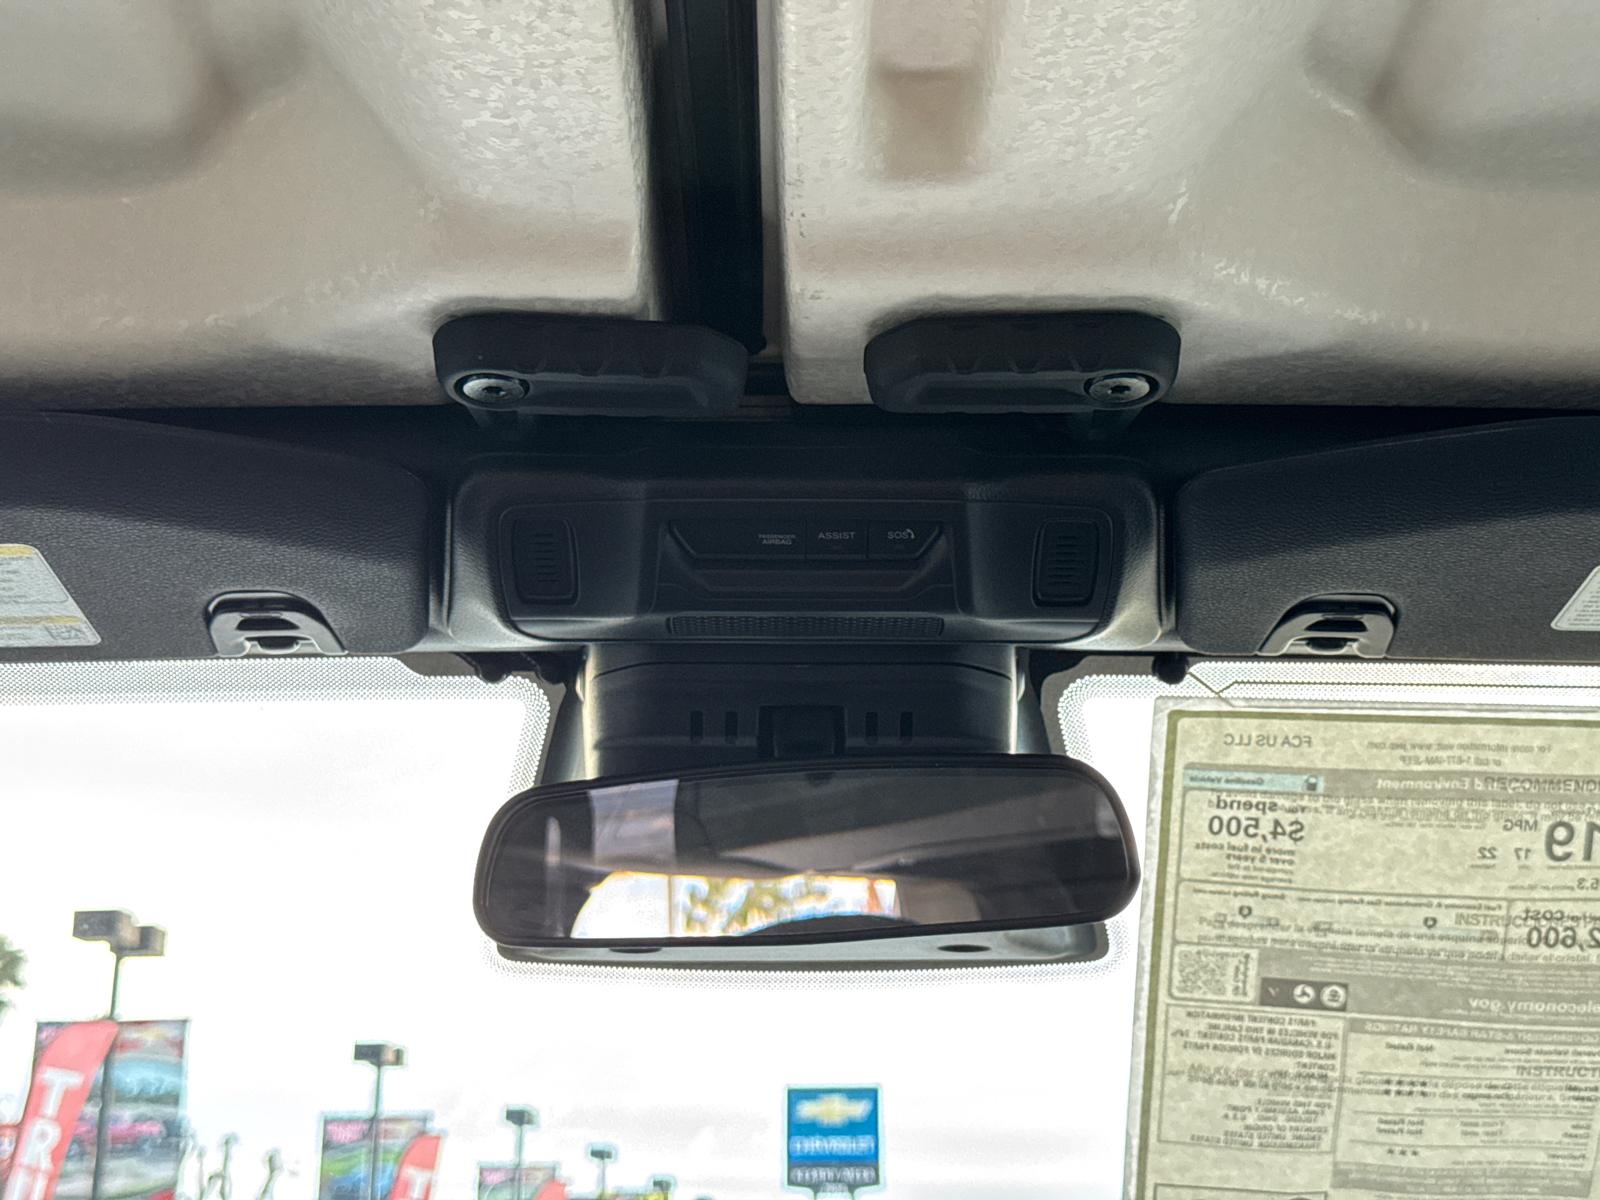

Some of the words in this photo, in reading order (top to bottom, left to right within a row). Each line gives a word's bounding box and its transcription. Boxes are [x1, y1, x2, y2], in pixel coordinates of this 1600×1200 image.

[818, 531, 855, 540] ASSIST
[887, 531, 909, 540] SOS
[762, 538, 793, 546] AIRBAG
[1484, 775, 1600, 794] RECOMMEND
